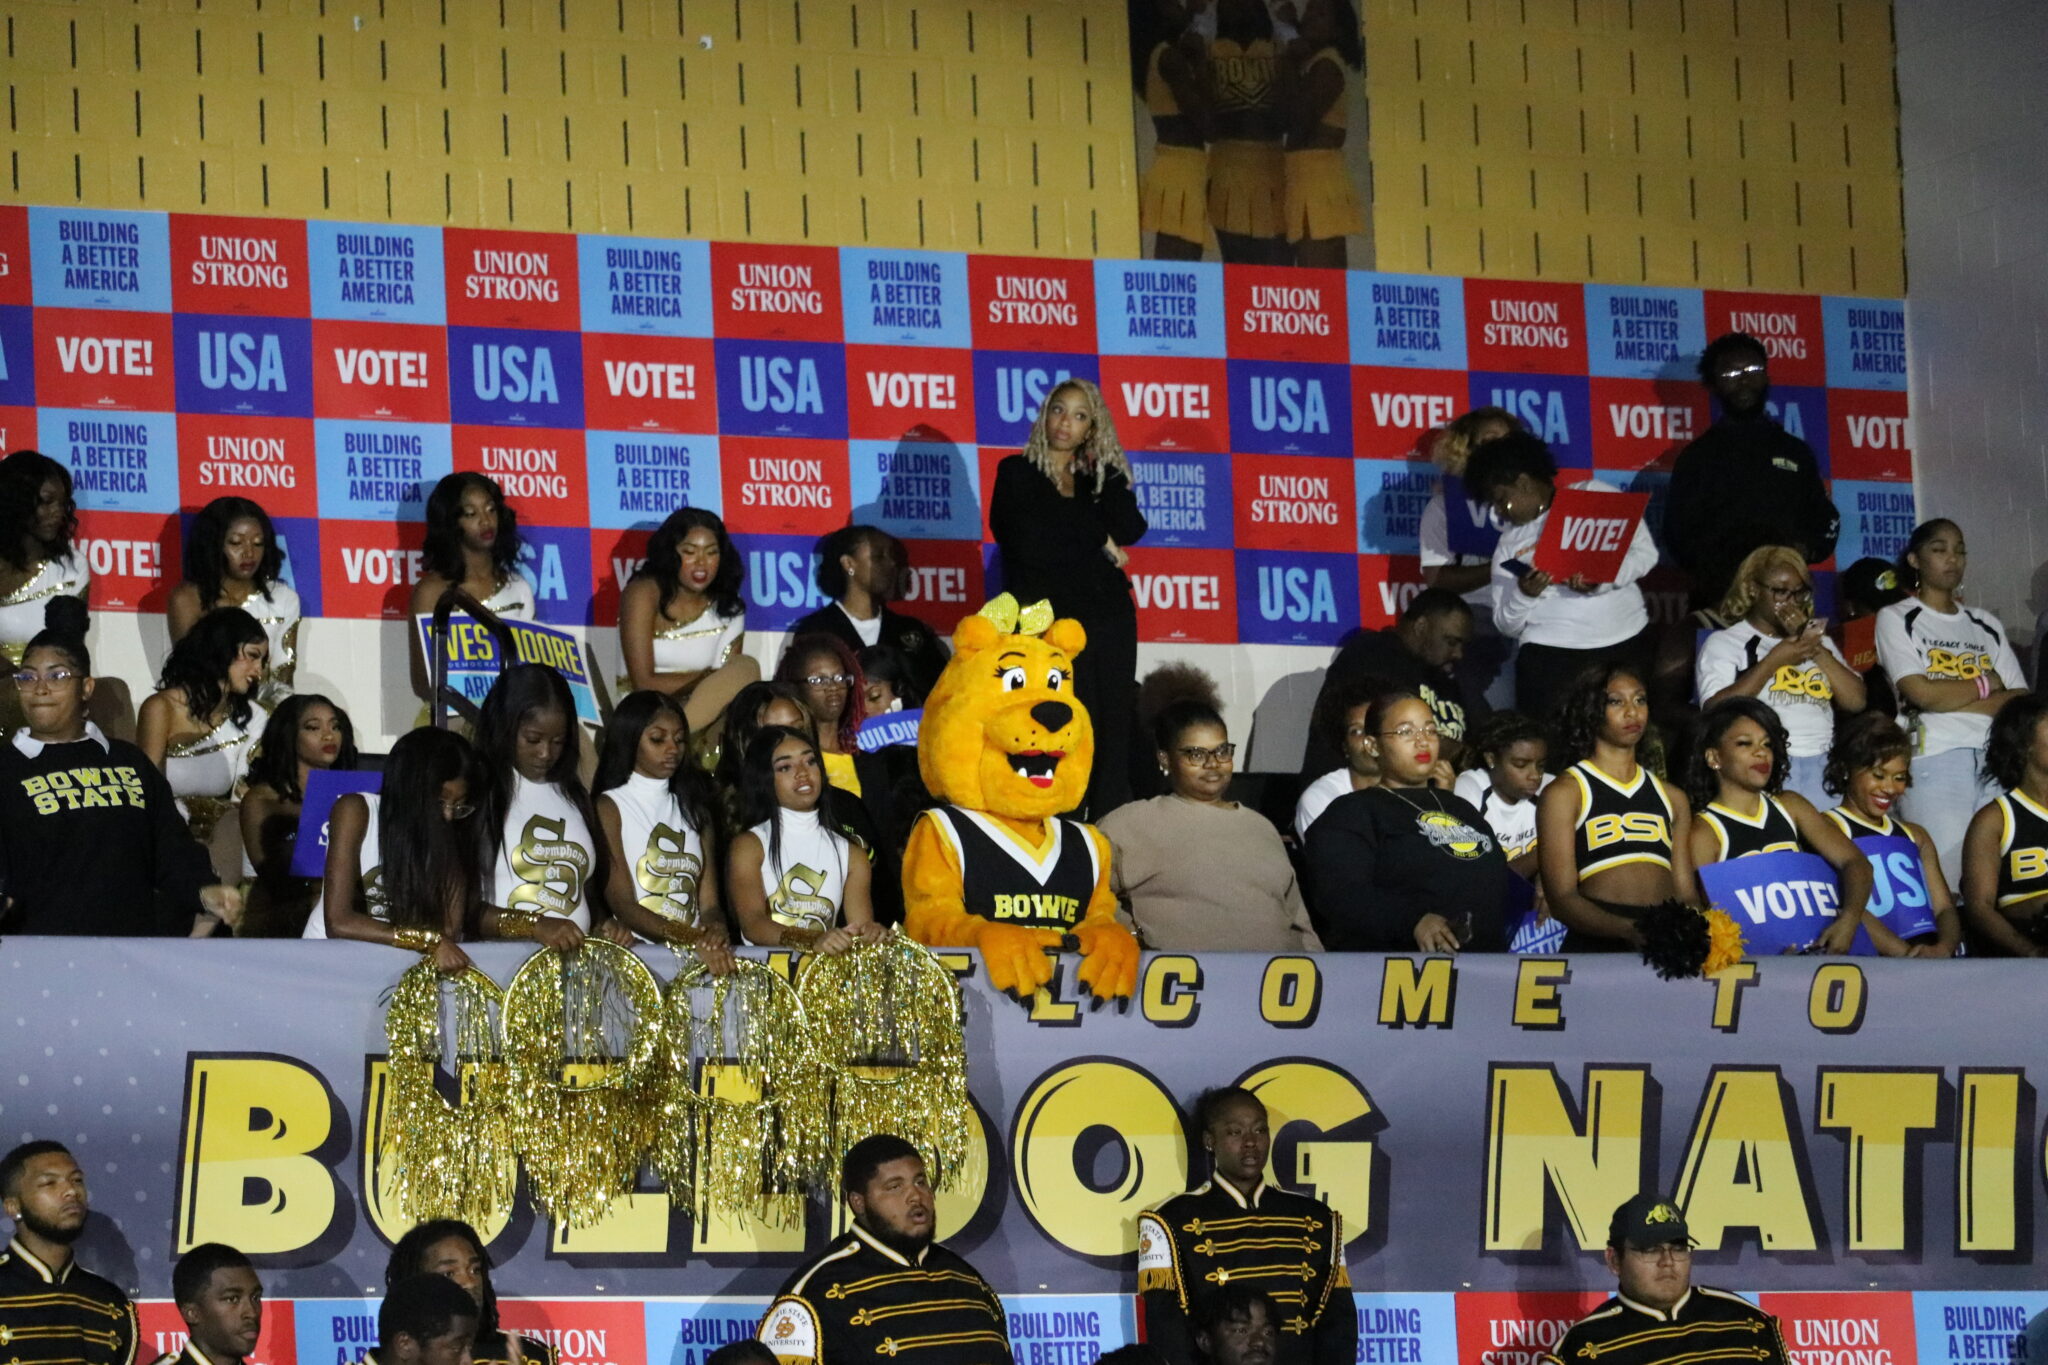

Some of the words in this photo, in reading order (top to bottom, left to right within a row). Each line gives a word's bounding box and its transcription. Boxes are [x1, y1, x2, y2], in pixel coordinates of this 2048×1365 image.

[59, 220, 140, 245] BUILDING
[62, 246, 74, 265] A
[78, 247, 140, 269] BETTER
[200, 236, 277, 262] UNION
[337, 233, 414, 258] BUILDING
[339, 259, 351, 279] A
[355, 260, 414, 282] BETTER
[473, 249, 549, 276] UNION
[606, 248, 681, 272] BUILDING
[868, 260, 941, 284] BUILDING
[64, 269, 140, 292] AMERICA
[192, 261, 288, 289] STRONG
[609, 273, 620, 292] A
[624, 274, 681, 295] BETTER
[738, 263, 812, 289] UNION
[1123, 271, 1197, 294] BUILDING
[341, 281, 414, 305] AMERICA
[466, 275, 559, 302] STRONG
[870, 285, 881, 304] A
[885, 286, 941, 307] BETTER
[996, 276, 1067, 301] UNION
[1251, 286, 1320, 310] UNION
[1372, 283, 1440, 306] BUILDING
[611, 295, 682, 318] AMERICA
[732, 288, 823, 315] STRONG
[989, 299, 1077, 327] STRONG
[1126, 296, 1137, 315] A
[1141, 296, 1197, 317] BETTER
[1490, 299, 1558, 324] UNION
[1610, 296, 1678, 319] BUILDING
[872, 306, 942, 329] AMERICA
[1128, 317, 1197, 339] AMERICA
[1243, 309, 1330, 336] STRONG
[1375, 308, 1385, 327] A
[1389, 308, 1441, 329] BETTER
[1730, 311, 1796, 336] UNION
[1849, 308, 1905, 331] BUILDIN
[1377, 329, 1441, 351] AMERICA
[1483, 322, 1568, 349] STRONG
[1612, 320, 1622, 338] A
[1626, 320, 1679, 342] BETTER
[1850, 332, 1860, 351] A
[1863, 333, 1905, 353] BETTE
[56, 336, 154, 376] VOTE!
[1615, 340, 1680, 363] AMERICA
[1758, 337, 1807, 360] ONG
[199, 331, 287, 392] USA
[334, 347, 428, 387] VOTE!
[472, 344, 560, 404] USA
[1853, 353, 1906, 374] AMERIC
[604, 361, 695, 399] VOTE!
[739, 355, 824, 414] USA
[866, 371, 956, 410] VOTE!
[1121, 382, 1210, 419] VOTE!
[1250, 376, 1330, 434] USA
[1370, 392, 1454, 429] VOTE!
[68, 421, 148, 446] BUILDING
[1609, 403, 1693, 441] VOTE!
[207, 436, 285, 462] UNION
[344, 432, 422, 456] BUILDING
[614, 443, 690, 467] BUILDING
[71, 446, 82, 466] A
[86, 447, 148, 470] BETTER
[347, 457, 358, 478] A
[362, 457, 422, 479] BETTER
[481, 447, 557, 473] UNION
[748, 458, 822, 483] UNION
[877, 452, 951, 476] BUILDING
[72, 469, 148, 493] AMERICA
[199, 461, 296, 488] STRONG
[490, 474, 568, 498] TRONG
[617, 468, 628, 488] A
[631, 469, 690, 490] BETTER
[1132, 463, 1205, 486] BUILDING
[349, 480, 422, 503] AMERICA
[742, 482, 832, 509] STRONG
[880, 477, 891, 497] A
[893, 478, 951, 499] BETTER
[1136, 487, 1145, 506] A
[1149, 487, 1206, 509] BETTER
[1258, 475, 1328, 500] UNION
[619, 490, 690, 513] AMERICA
[882, 498, 952, 521] AMERICA
[1251, 499, 1338, 525] STRONG
[1384, 495, 1393, 514] A
[1857, 491, 1915, 514] BUILDIN
[1142, 508, 1206, 531] MERICA
[1860, 514, 1869, 534] A
[1873, 515, 1916, 536] BETTE
[1560, 516, 1628, 551] VOTE!
[341, 548, 424, 585] VOTE
[518, 543, 568, 600] SA
[908, 566, 966, 603] OTE!
[1130, 573, 1220, 610] VOTE!
[1257, 566, 1338, 623] USA
[857, 720, 919, 751] UILDIN
[21, 766, 143, 798] BOWIE
[34, 784, 146, 816] STATE
[533, 844, 588, 867] Symphony
[536, 890, 566, 911] Soul
[661, 901, 687, 921] Soul
[994, 894, 1080, 923] BOWIE
[1735, 879, 1840, 925] VOTE!
[1706, 961, 1869, 1035] TO
[1479, 1060, 2048, 1267] NATI
[681, 1318, 760, 1345] BUILDIN
[1010, 1312, 1100, 1339] BUILDING
[1357, 1308, 1421, 1335] ILDING
[1943, 1306, 2027, 1333] BUILDING
[511, 1328, 607, 1358] NION
[766, 1339, 806, 1347] NIVERSITY
[1489, 1319, 1575, 1347] UNION
[1794, 1319, 1879, 1347] UNION
[1014, 1343, 1025, 1365] A
[1029, 1341, 1100, 1365] BETTER
[1949, 1335, 1958, 1359] A
[1963, 1335, 2028, 1360] BETTER
